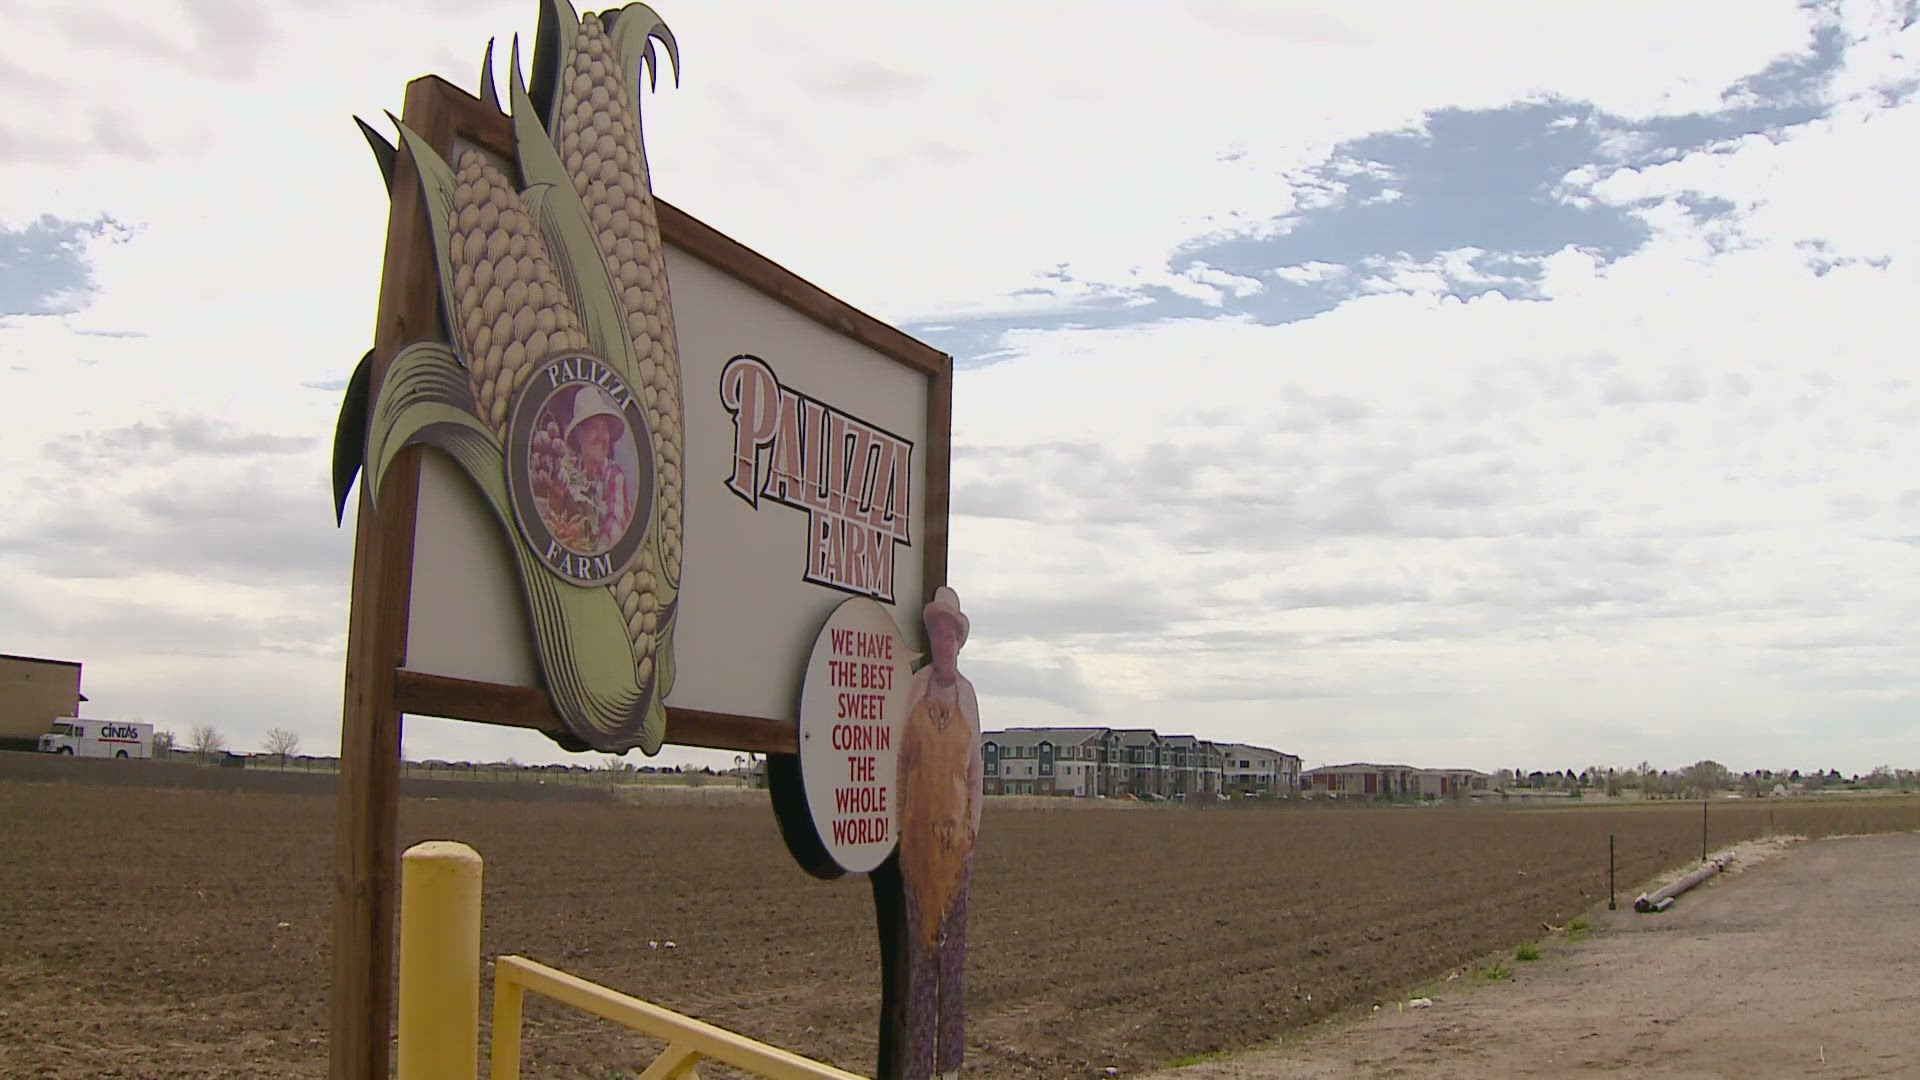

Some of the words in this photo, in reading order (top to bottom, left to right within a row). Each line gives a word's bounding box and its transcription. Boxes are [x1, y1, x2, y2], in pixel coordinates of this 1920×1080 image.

[546, 540, 613, 580] FARM
[805, 510, 894, 602] FARM
[831, 628, 853, 656] WE
[857, 632, 892, 660] HAVE
[828, 660, 857, 688] THE
[861, 664, 894, 691] BEST
[838, 693, 885, 720] SWEET
[101, 723, 138, 739] CINTAS
[832, 725, 872, 751] CORN
[876, 726, 890, 751] IN
[848, 757, 875, 782] THE
[835, 787, 886, 813] WHOLE
[832, 817, 888, 846] WORLD!
